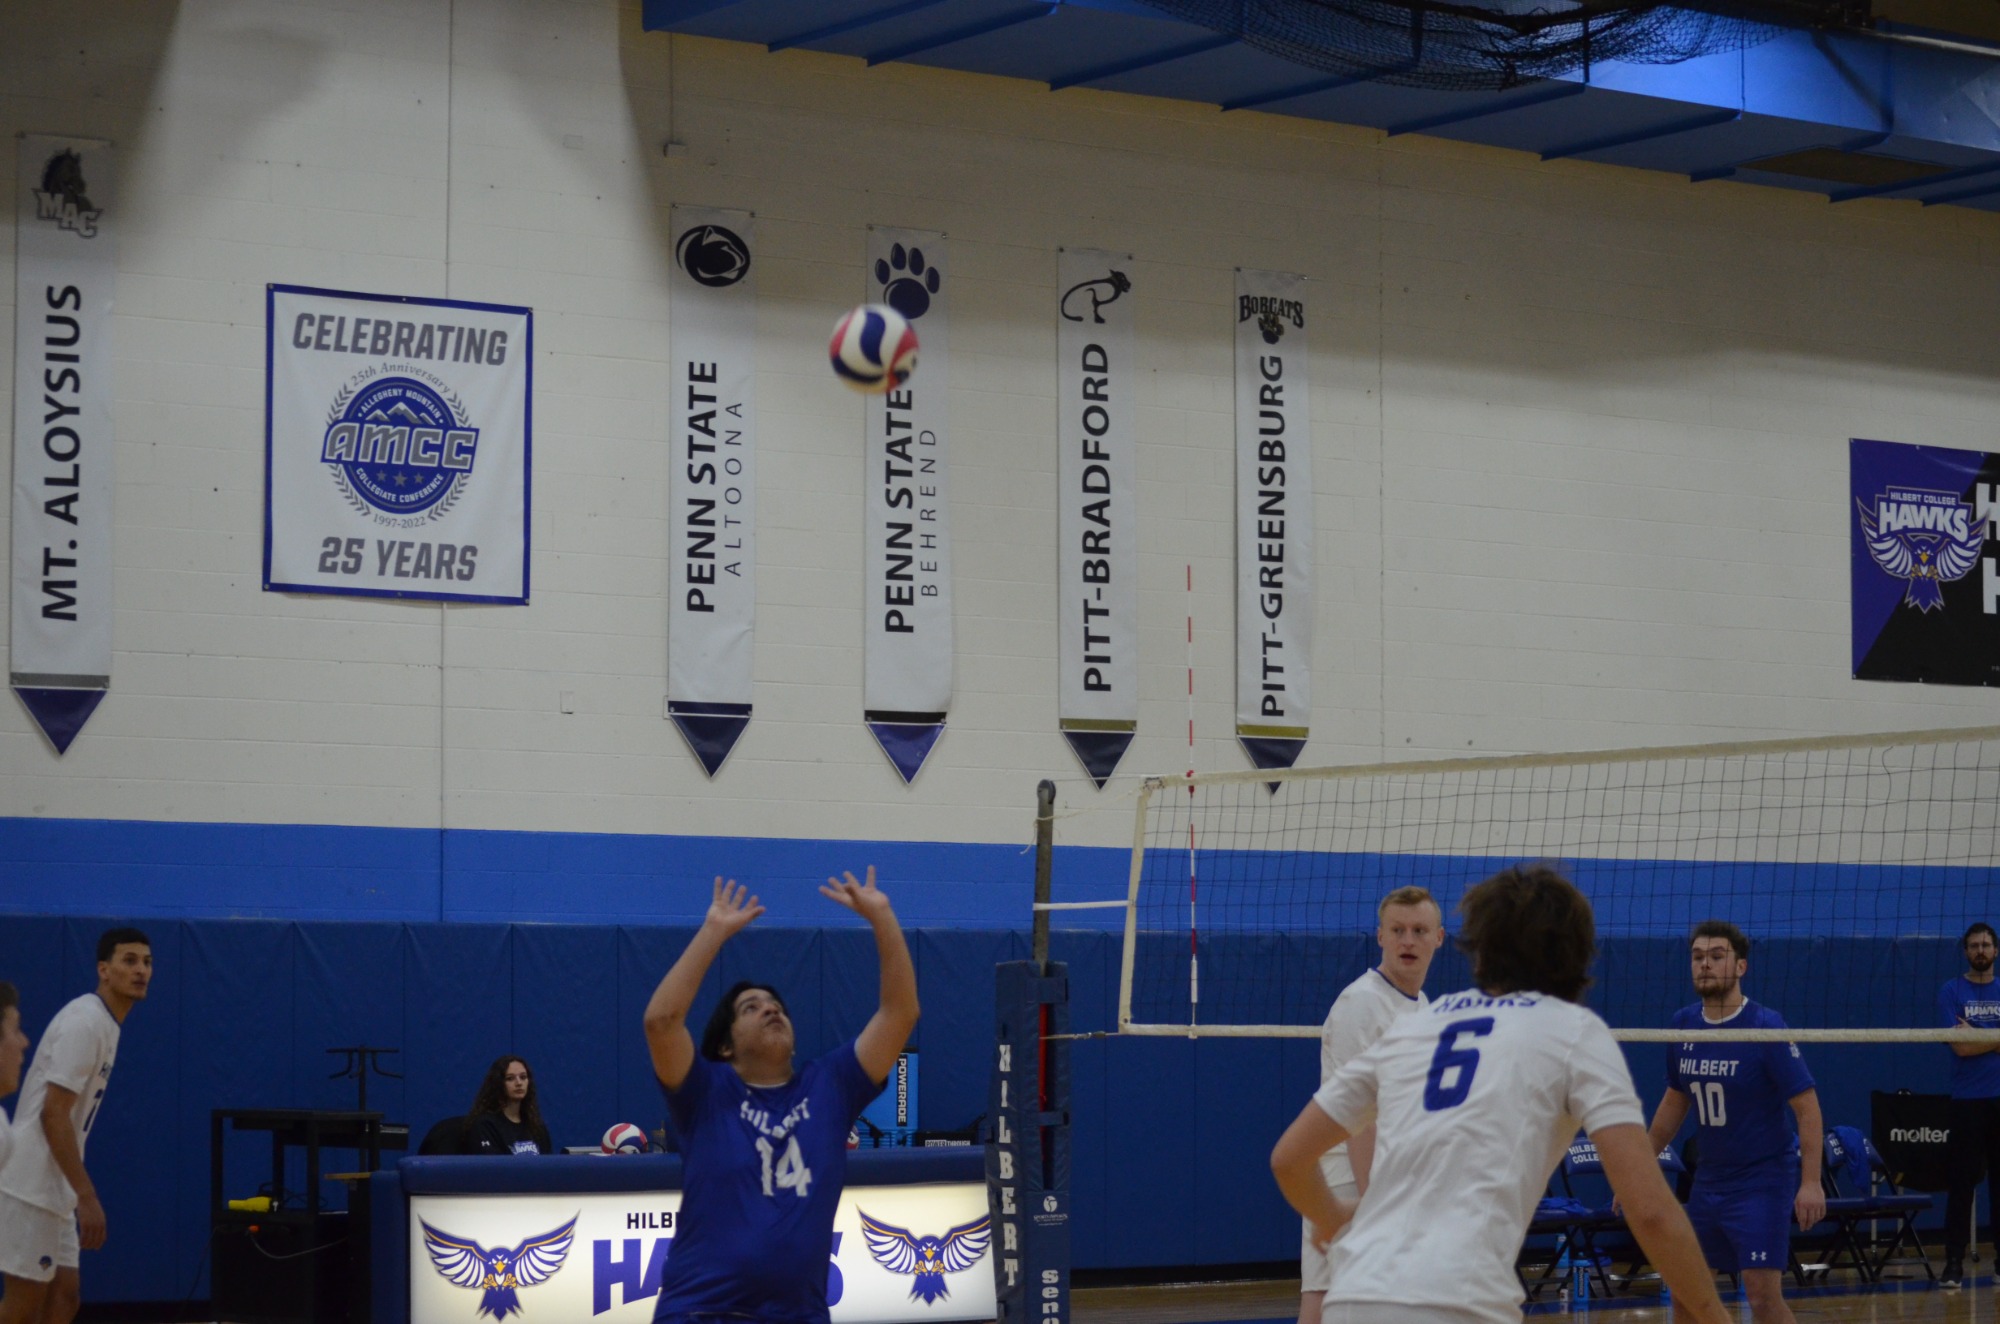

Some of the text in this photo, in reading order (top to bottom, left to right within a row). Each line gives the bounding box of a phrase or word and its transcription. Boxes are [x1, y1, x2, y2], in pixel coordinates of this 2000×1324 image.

[31, 187, 103, 238] MAC
[1239, 294, 1304, 329] BOBCATS
[292, 313, 507, 366] CELEBRATING
[351, 362, 450, 394] 25th Anniversary
[361, 388, 442, 419] ALLEGHENY MOUNTAIN
[41, 284, 82, 621] MT. ALOYSIUS
[324, 422, 476, 470] AMCC
[356, 468, 444, 503] COLLEGIATE CONFERENCE
[686, 361, 717, 613] PENN STATE
[724, 402, 742, 577] ALTOONA
[1890, 491, 1957, 506] HILBERT COLLEGE
[373, 513, 426, 528] 1997-2022
[885, 389, 914, 633] PENN STATE
[919, 429, 938, 597] BEHREND
[1082, 343, 1112, 692] PITT-BRADFORD
[1879, 501, 1969, 542] HAWKS
[318, 536, 478, 581] 25 YEARS
[1258, 355, 1286, 717] PITT-GREENSBURG
[1423, 1016, 1495, 1112] 6
[1680, 1058, 1739, 1077] HILBERT
[898, 1058, 907, 1123] POWERADE
[1690, 1081, 1727, 1127] 10
[755, 1135, 812, 1197] 14
[1568, 1144, 1597, 1155] HILBE
[1572, 1153, 1600, 1164] COLLE
[627, 1212, 677, 1229] HILB
